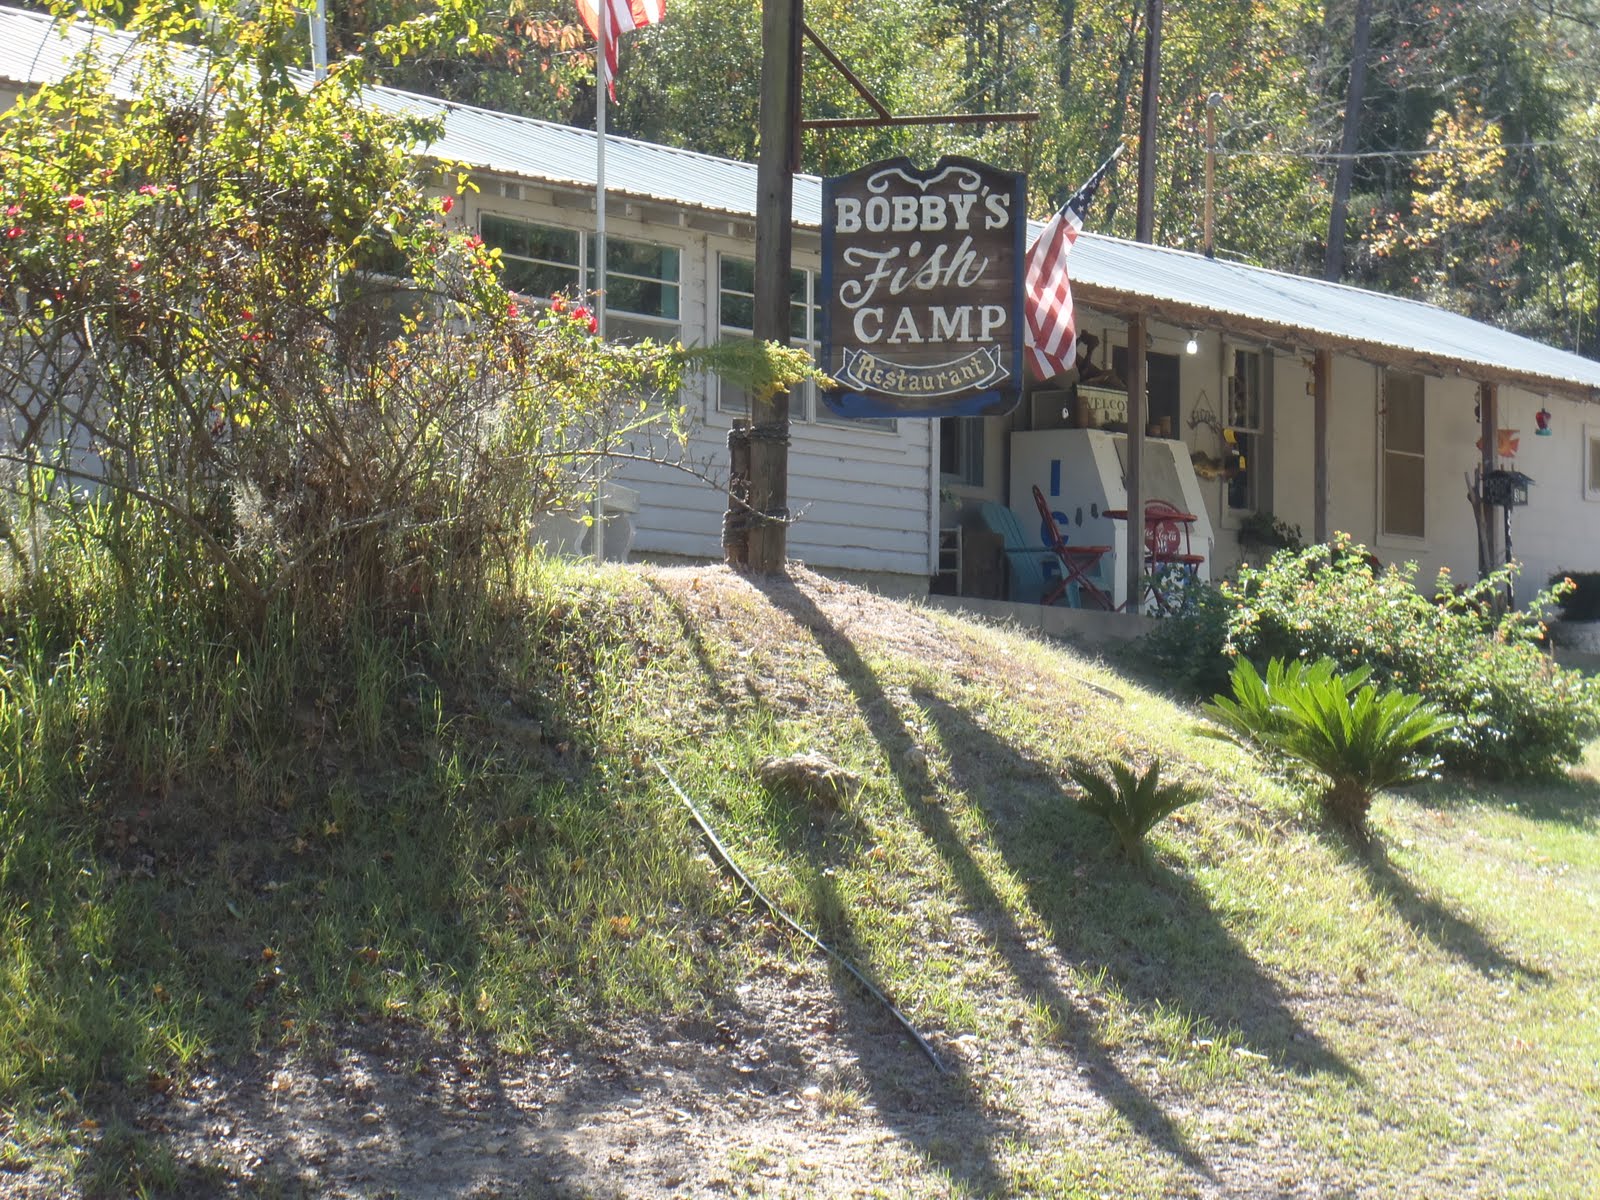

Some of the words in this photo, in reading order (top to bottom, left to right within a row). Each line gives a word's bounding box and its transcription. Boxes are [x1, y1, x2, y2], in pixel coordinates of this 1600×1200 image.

[835, 186, 1010, 233] BOBBY'S
[839, 235, 989, 309] Fish
[853, 305, 1007, 344] CAMP
